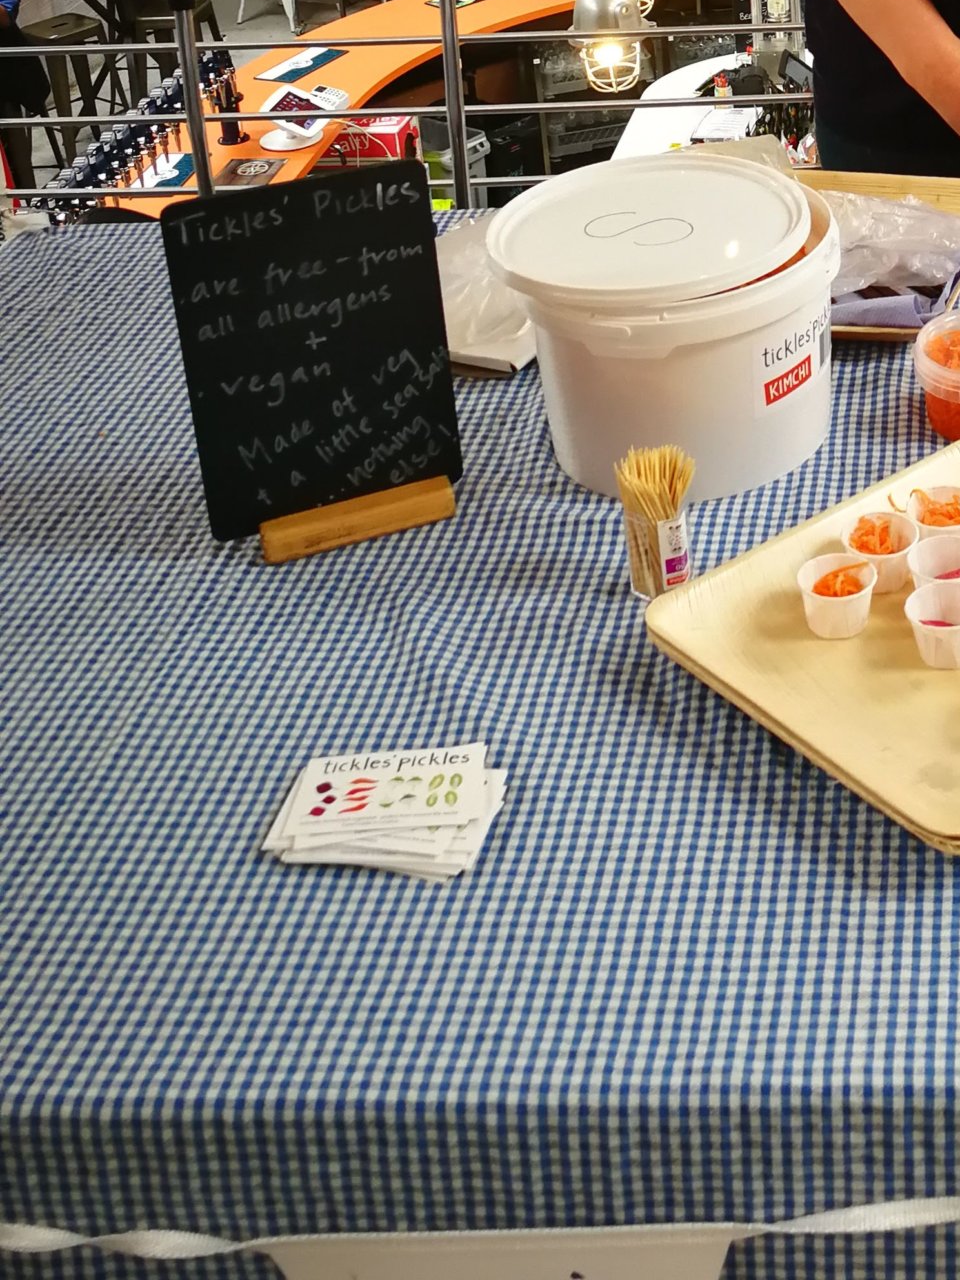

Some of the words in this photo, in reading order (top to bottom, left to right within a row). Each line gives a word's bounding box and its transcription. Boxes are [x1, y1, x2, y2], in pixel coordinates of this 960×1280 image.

[313, 181, 420, 218] Pickles
[191, 277, 240, 304] are
[199, 315, 235, 342] all
[257, 284, 392, 328] allergens
[221, 362, 331, 407] vegan
[769, 360, 809, 400] KIMCHI
[238, 420, 314, 471] Made
[332, 387, 357, 418] of
[371, 348, 420, 385] veg
[290, 470, 306, 487] a
[315, 416, 373, 464] little
[382, 383, 420, 419] sea
